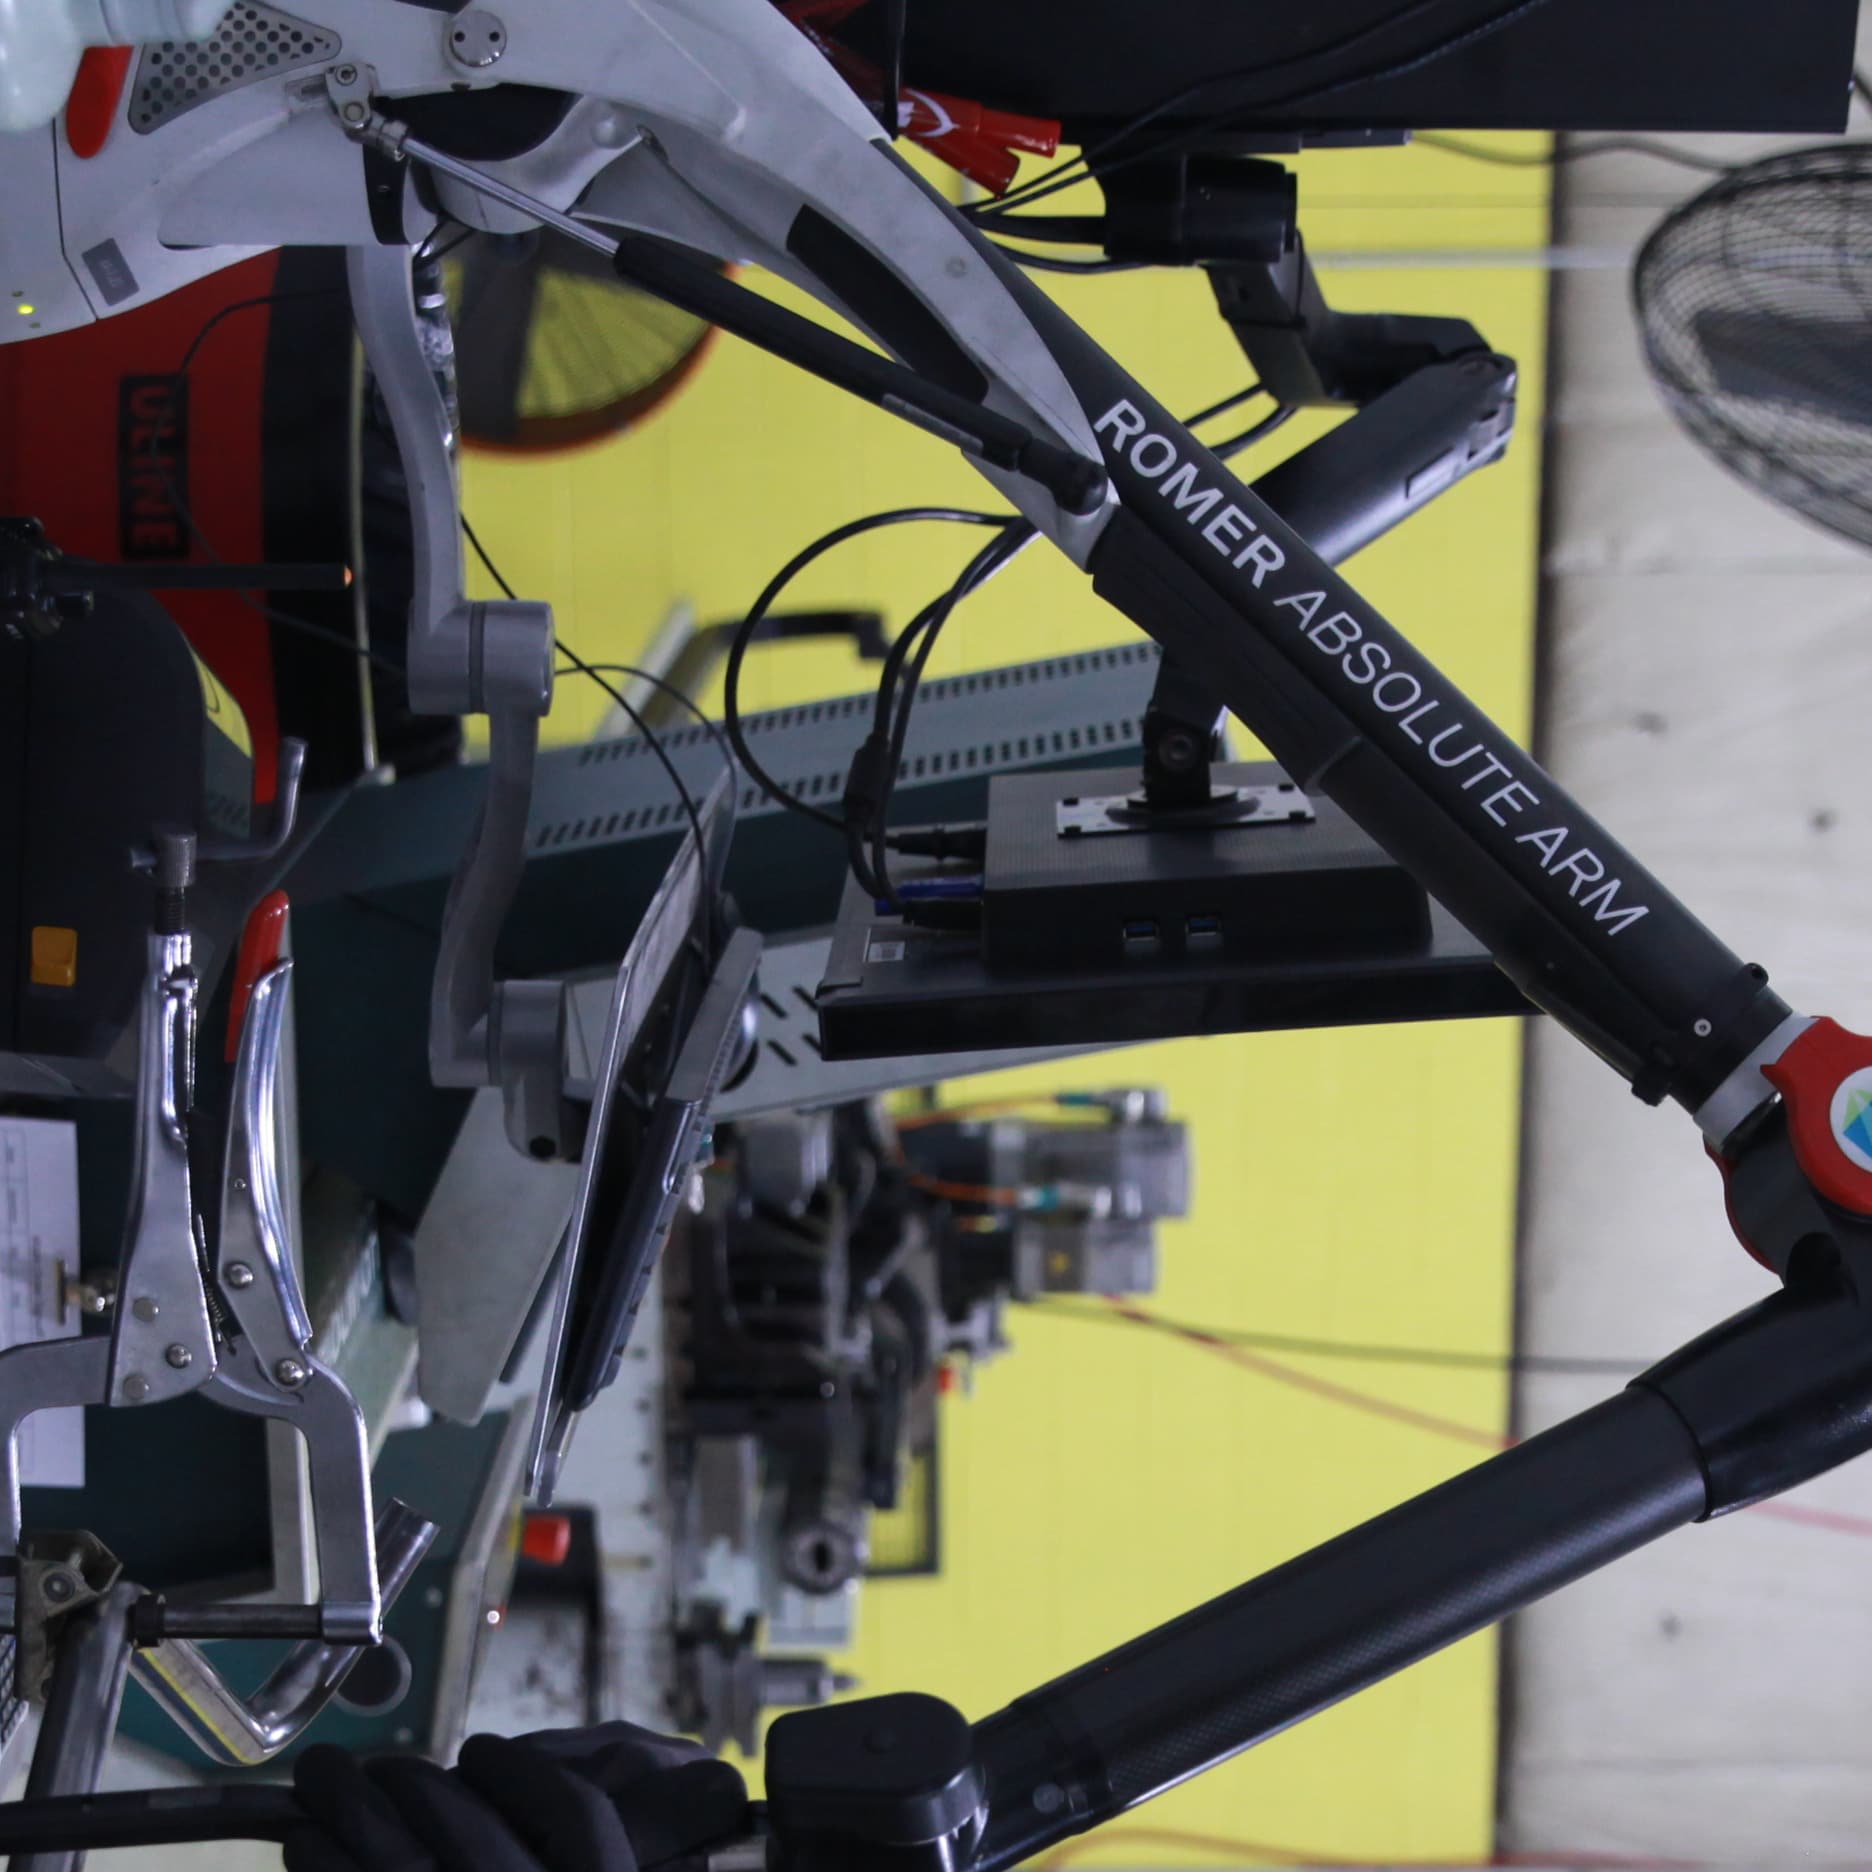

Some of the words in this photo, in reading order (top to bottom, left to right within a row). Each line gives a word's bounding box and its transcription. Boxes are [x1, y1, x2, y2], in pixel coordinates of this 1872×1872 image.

[130, 385, 178, 548] ULINE
[1094, 399, 1286, 589] ROMER
[1273, 591, 1540, 828] ABSOLUTE
[1515, 826, 1650, 937] ARM
